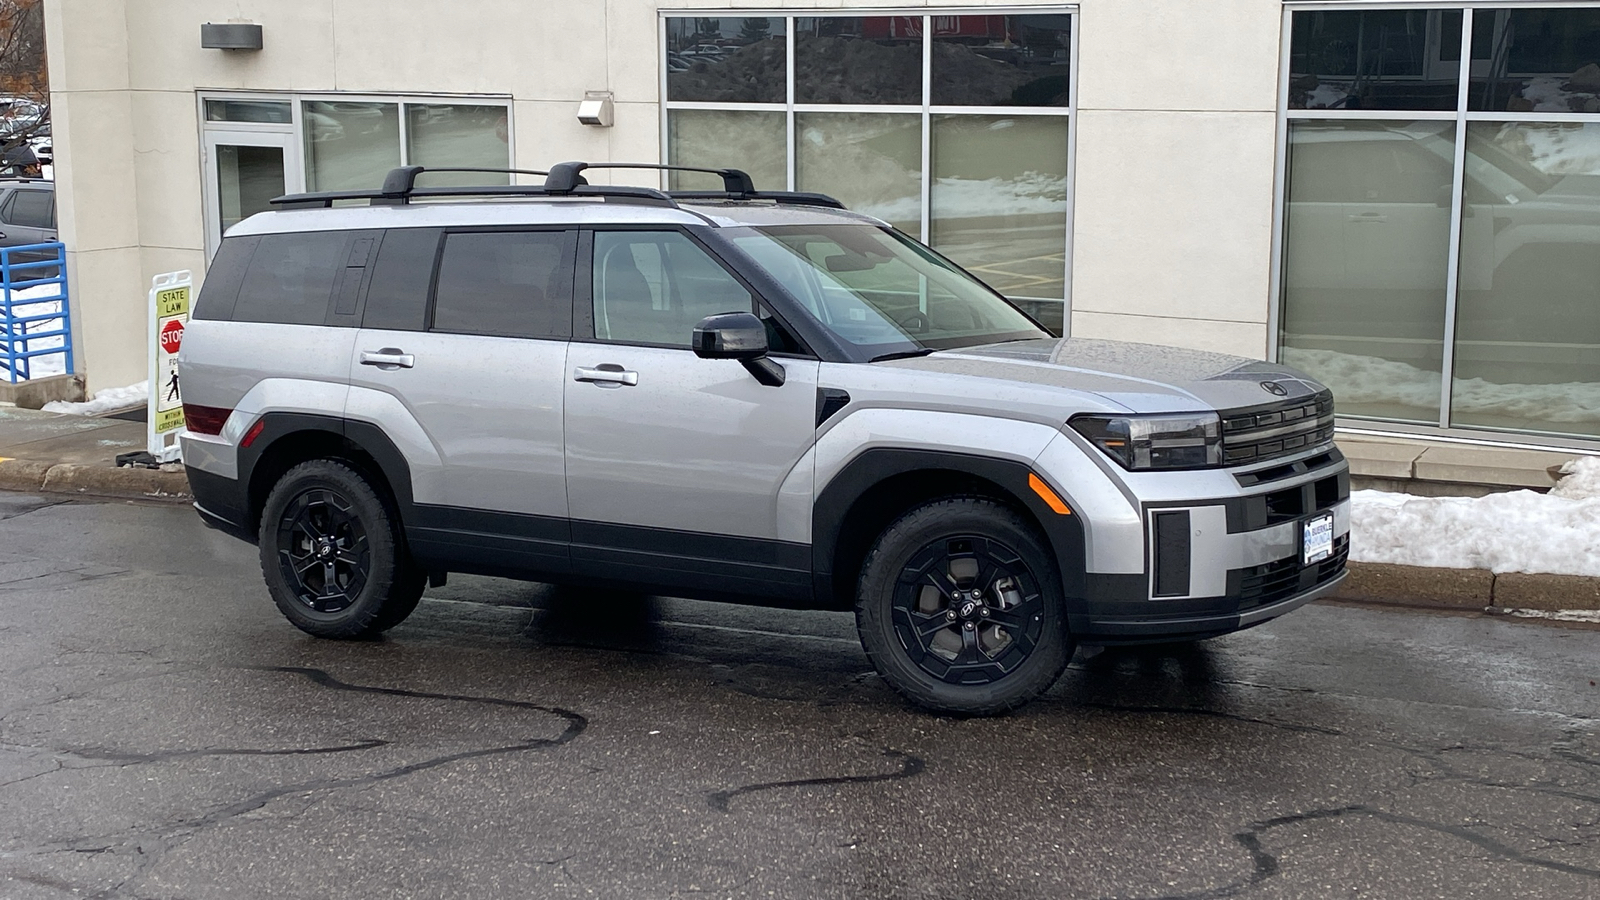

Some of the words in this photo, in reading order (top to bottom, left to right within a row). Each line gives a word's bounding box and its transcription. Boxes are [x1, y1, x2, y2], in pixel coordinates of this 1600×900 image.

[162, 290, 184, 302] STATE
[166, 302, 181, 313] LAW
[162, 329, 183, 344] STOP
